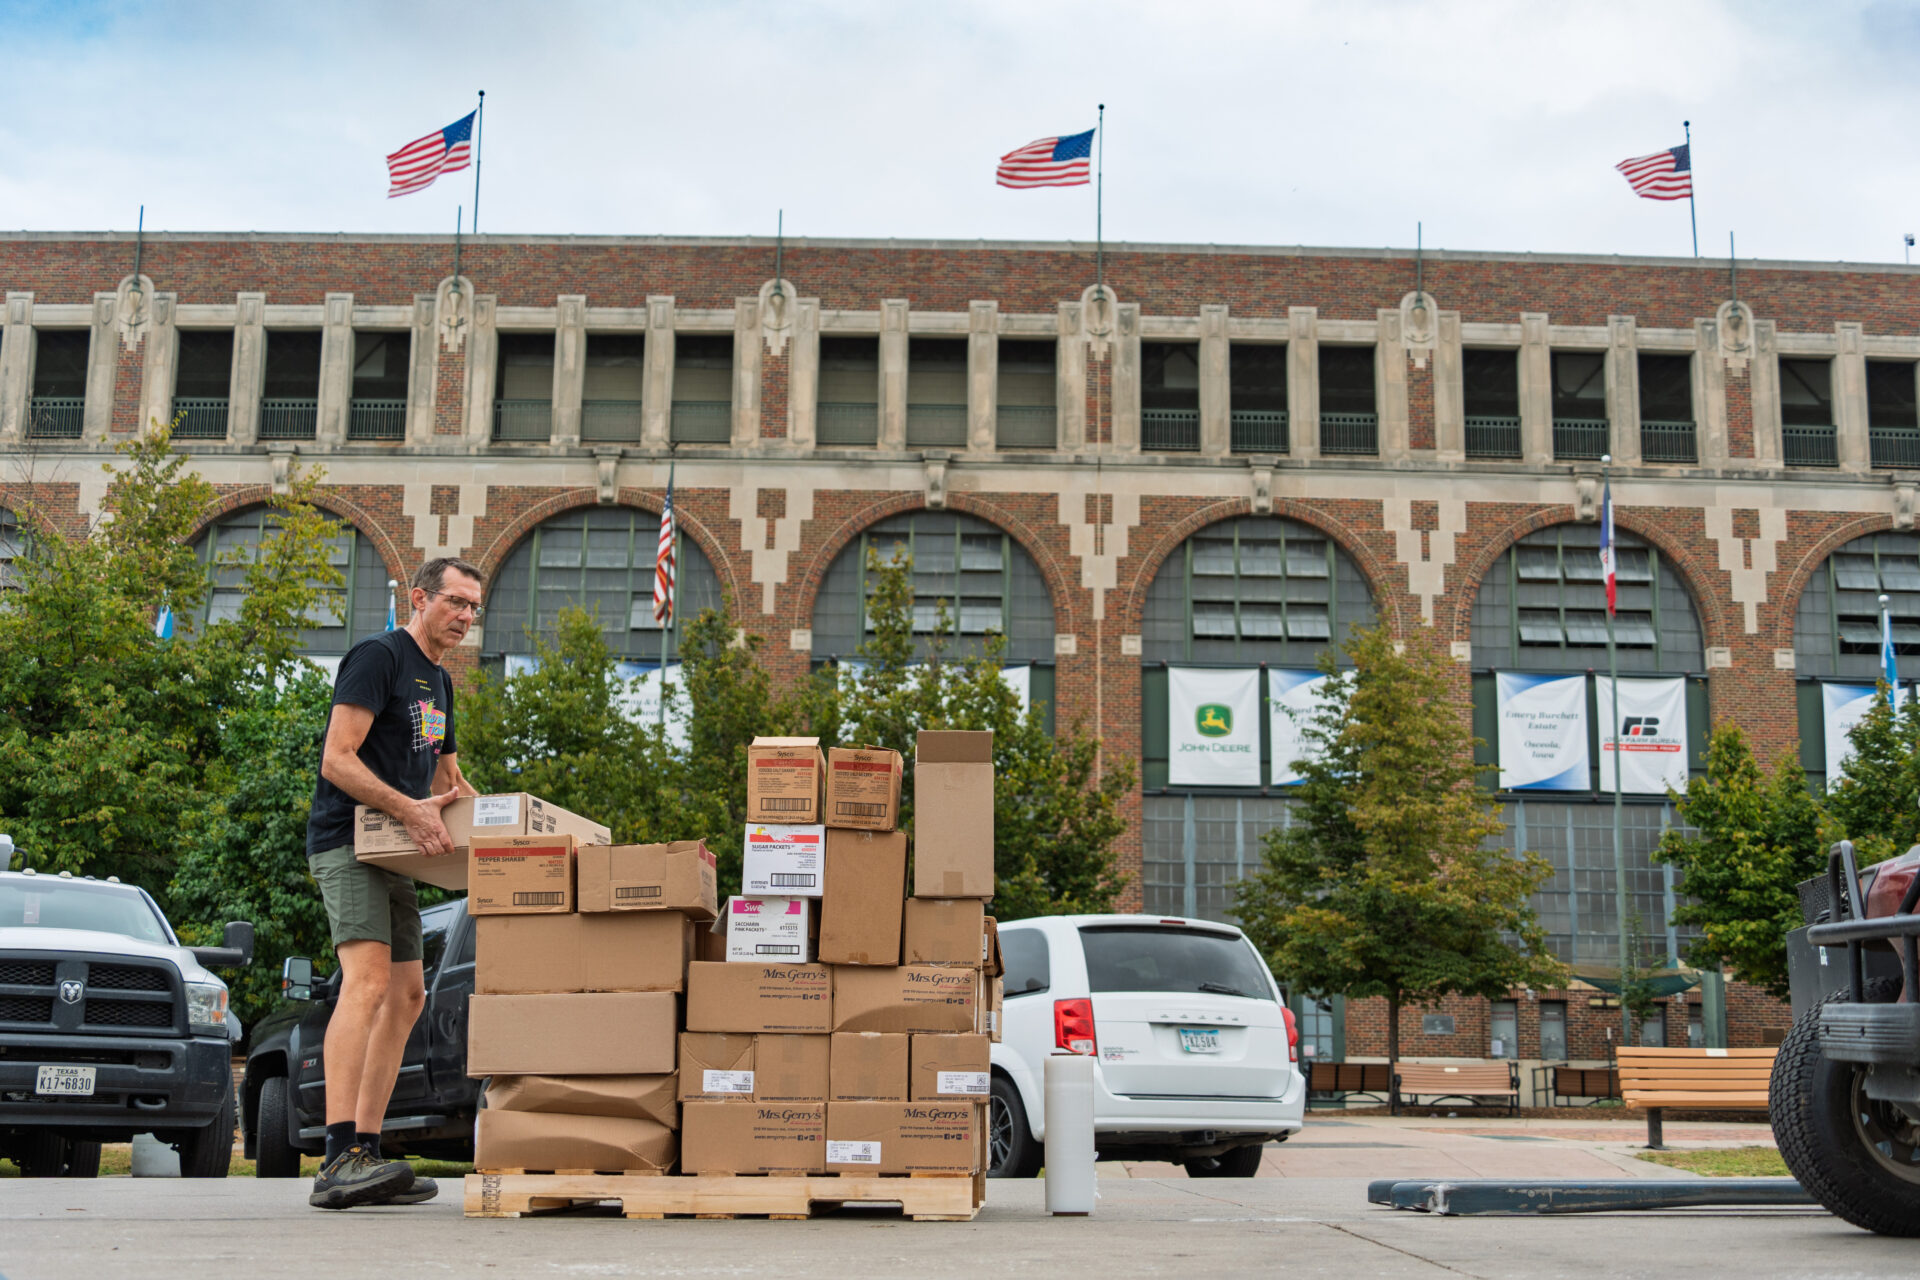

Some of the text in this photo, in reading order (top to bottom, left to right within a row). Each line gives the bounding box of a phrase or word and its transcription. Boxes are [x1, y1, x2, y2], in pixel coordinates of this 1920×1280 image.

[1505, 711, 1579, 720] Emery Burchett
[1528, 722, 1558, 730] Estate
[1178, 742, 1252, 753] JOHN DEERE
[1532, 751, 1555, 759] Iowa
